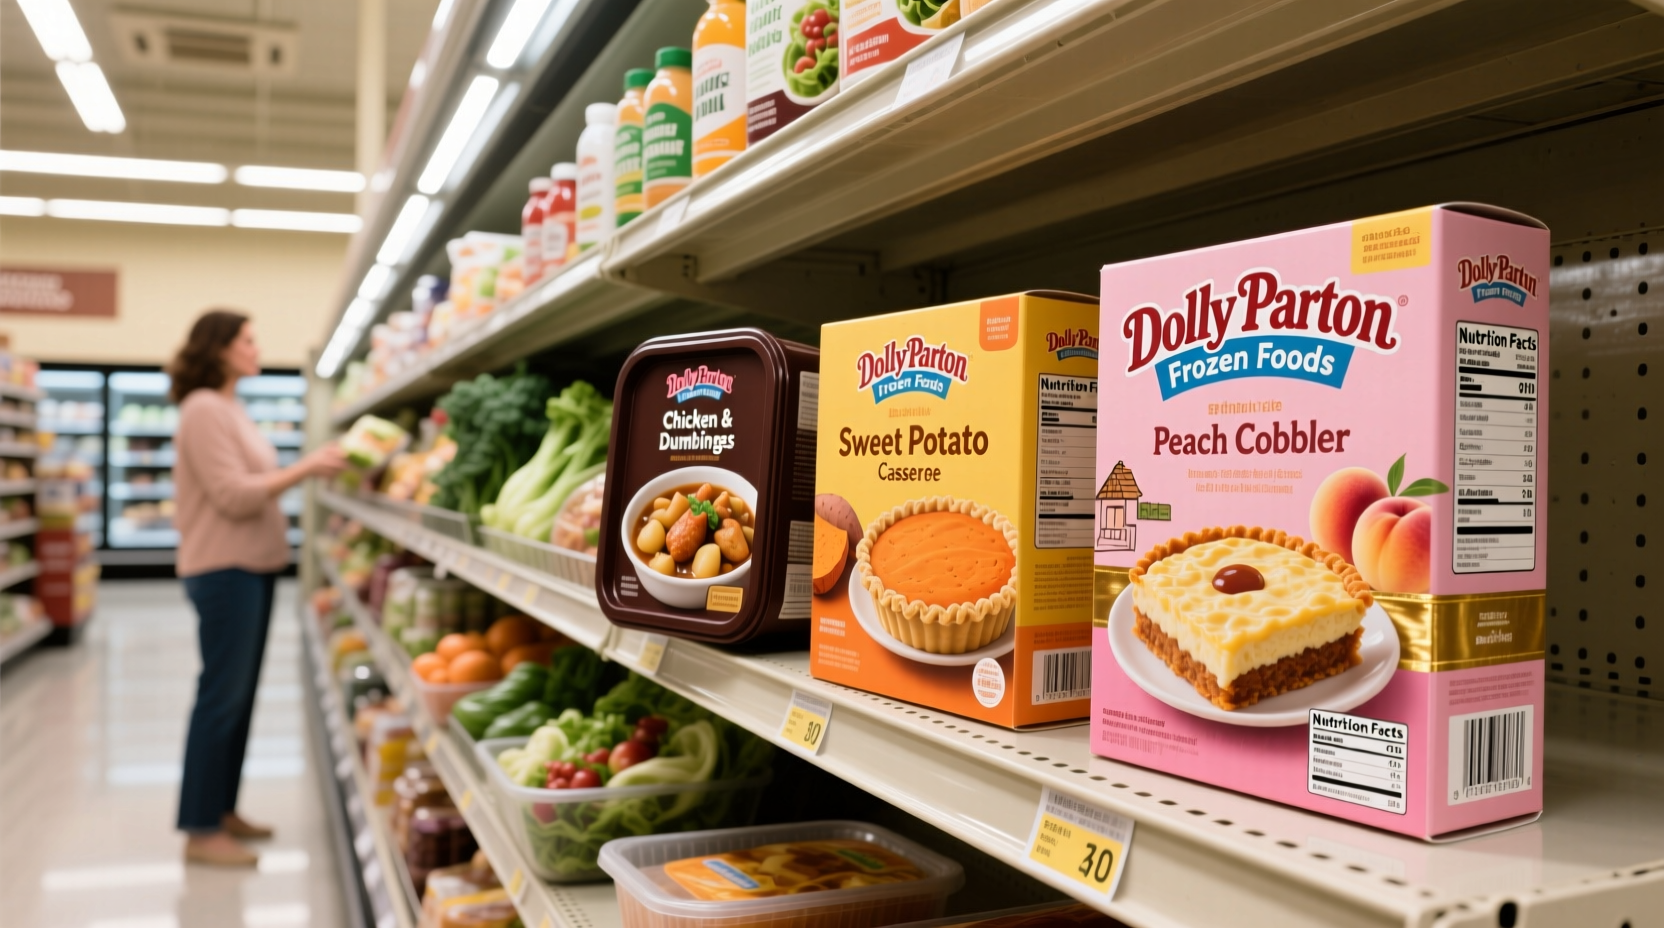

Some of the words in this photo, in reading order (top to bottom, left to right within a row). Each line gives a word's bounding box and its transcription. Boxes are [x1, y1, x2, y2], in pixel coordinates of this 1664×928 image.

[1123, 271, 1239, 373] Dolly
[1237, 271, 1397, 351] Parton
[857, 341, 910, 389] Dolly
[906, 337, 968, 382] Parton
[1168, 351, 1249, 389] Frozen
[1256, 342, 1337, 377] Foods
[662, 408, 718, 430] Chicken
[721, 408, 733, 428] &
[1153, 423, 1228, 456] Peach
[1235, 418, 1351, 456] Cobbler
[839, 426, 903, 457] Sweet
[908, 424, 989, 456] Potato
[1371, 722, 1404, 739] Facts
